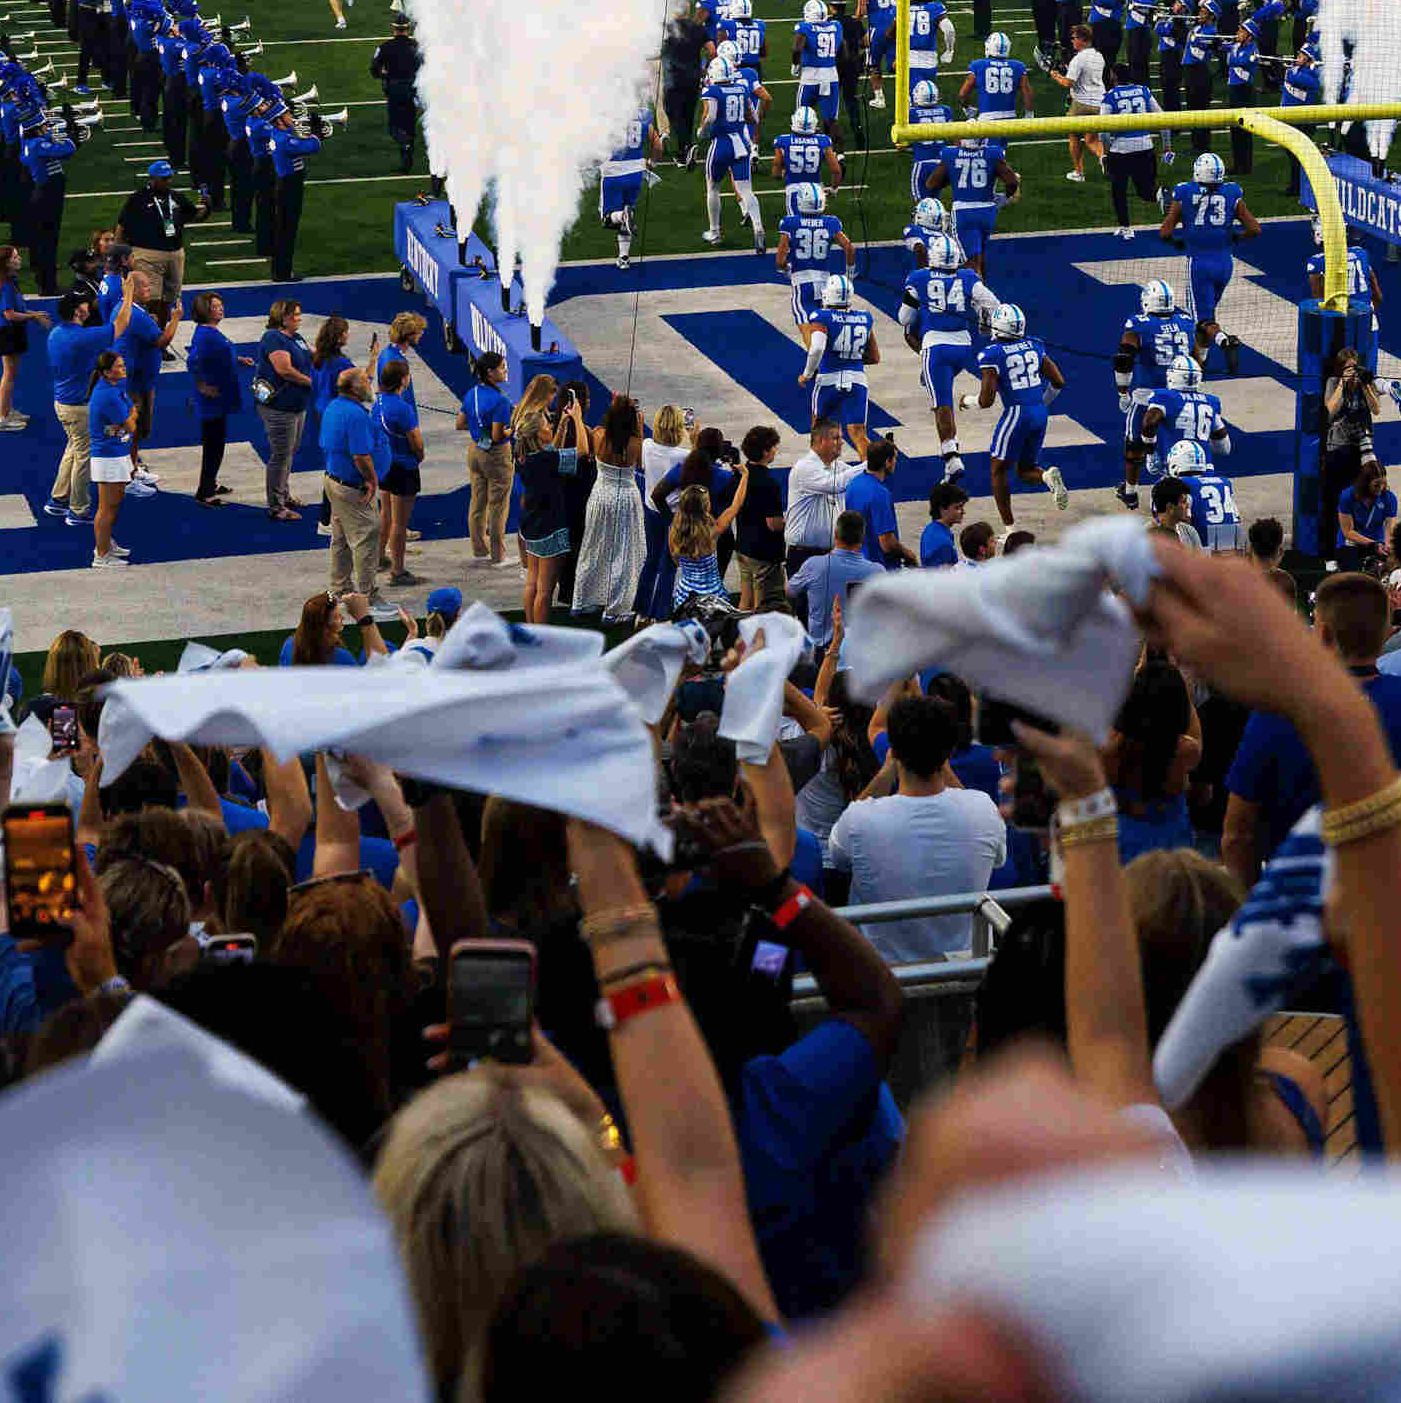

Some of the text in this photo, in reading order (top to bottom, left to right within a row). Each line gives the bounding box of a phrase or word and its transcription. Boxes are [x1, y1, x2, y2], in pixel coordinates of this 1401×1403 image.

[817, 32, 837, 58] 91
[984, 67, 1014, 94] 66
[790, 145, 820, 173] 59
[955, 158, 988, 189] 76
[1192, 194, 1226, 225] 73
[795, 228, 830, 260] 36
[926, 279, 967, 314] 94
[833, 325, 868, 360] 42
[1006, 350, 1043, 391] 22
[1175, 402, 1214, 442] 46
[1199, 484, 1240, 525] 34
